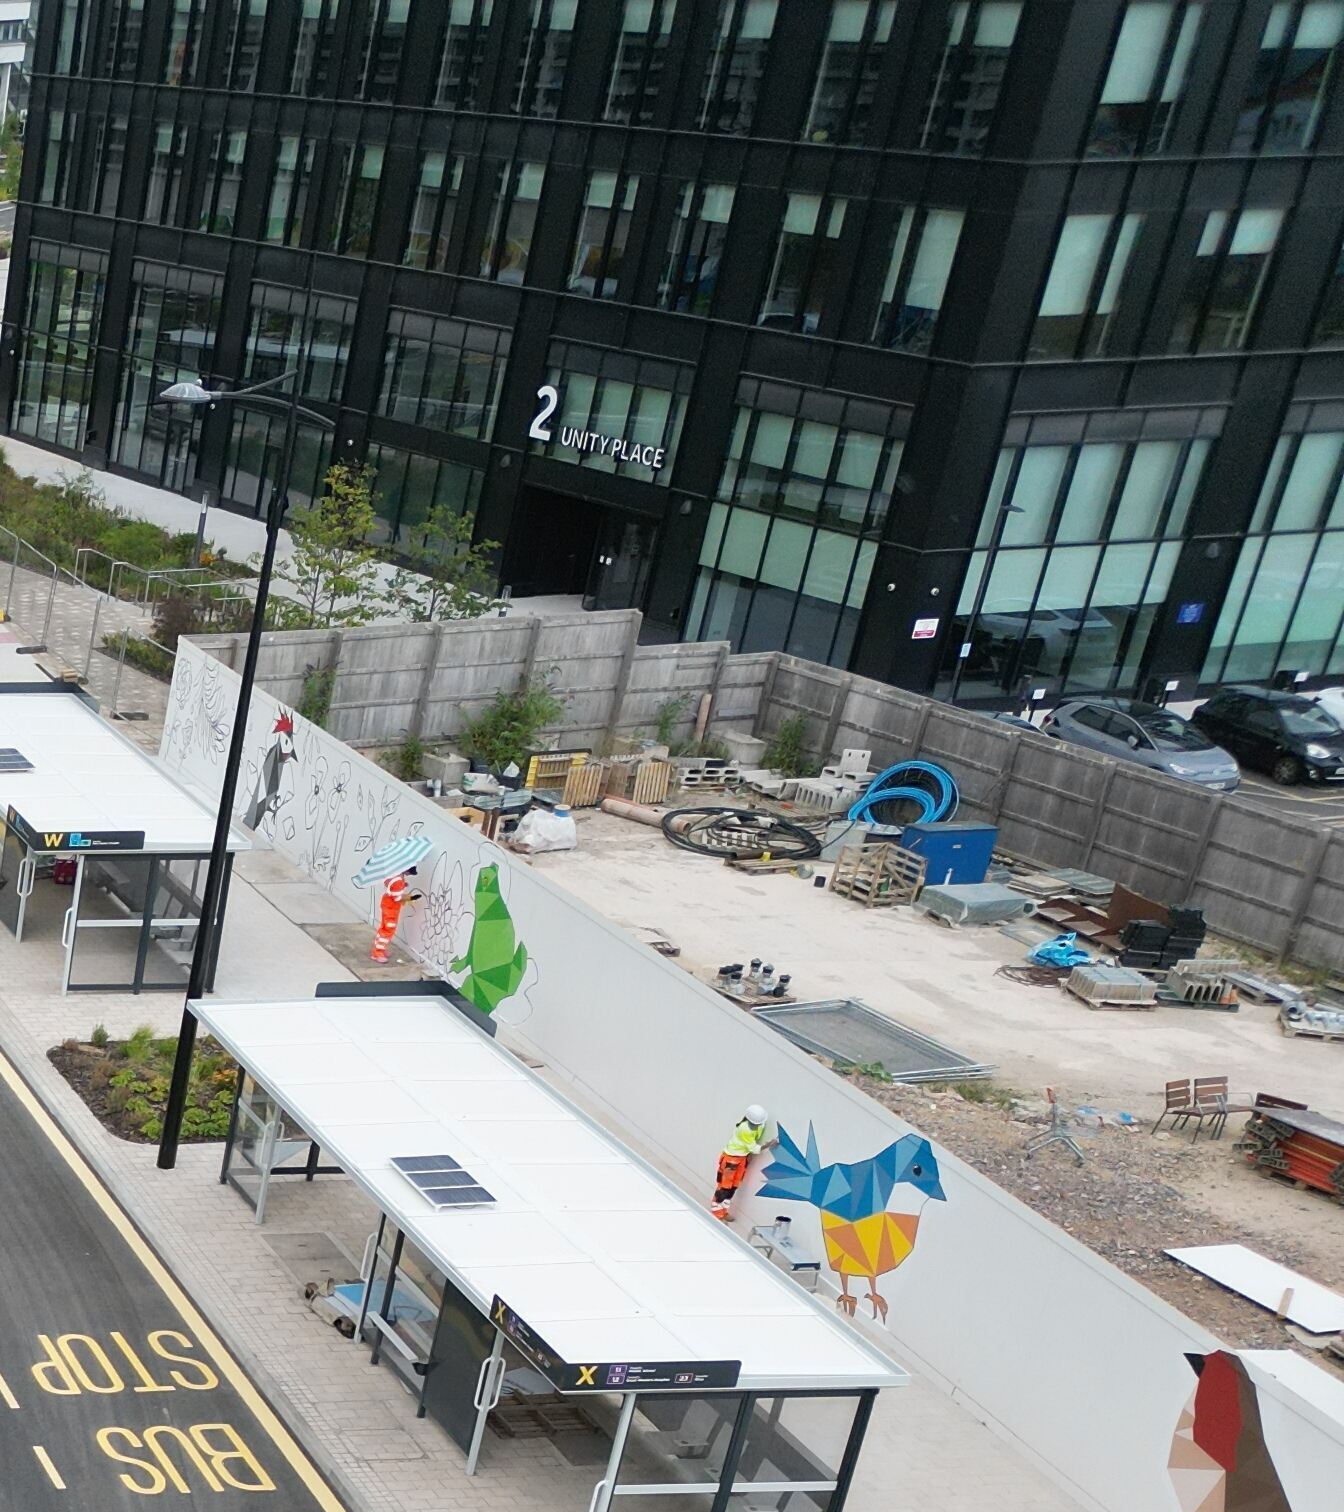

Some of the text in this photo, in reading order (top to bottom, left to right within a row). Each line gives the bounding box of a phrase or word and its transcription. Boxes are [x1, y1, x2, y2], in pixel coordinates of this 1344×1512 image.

[528, 385, 665, 468] 2 UNITY PLACE
[44, 833, 64, 848] W
[31, 1329, 220, 1394] STOP
[575, 1365, 598, 1386] X
[96, 1423, 278, 1495] BUS
